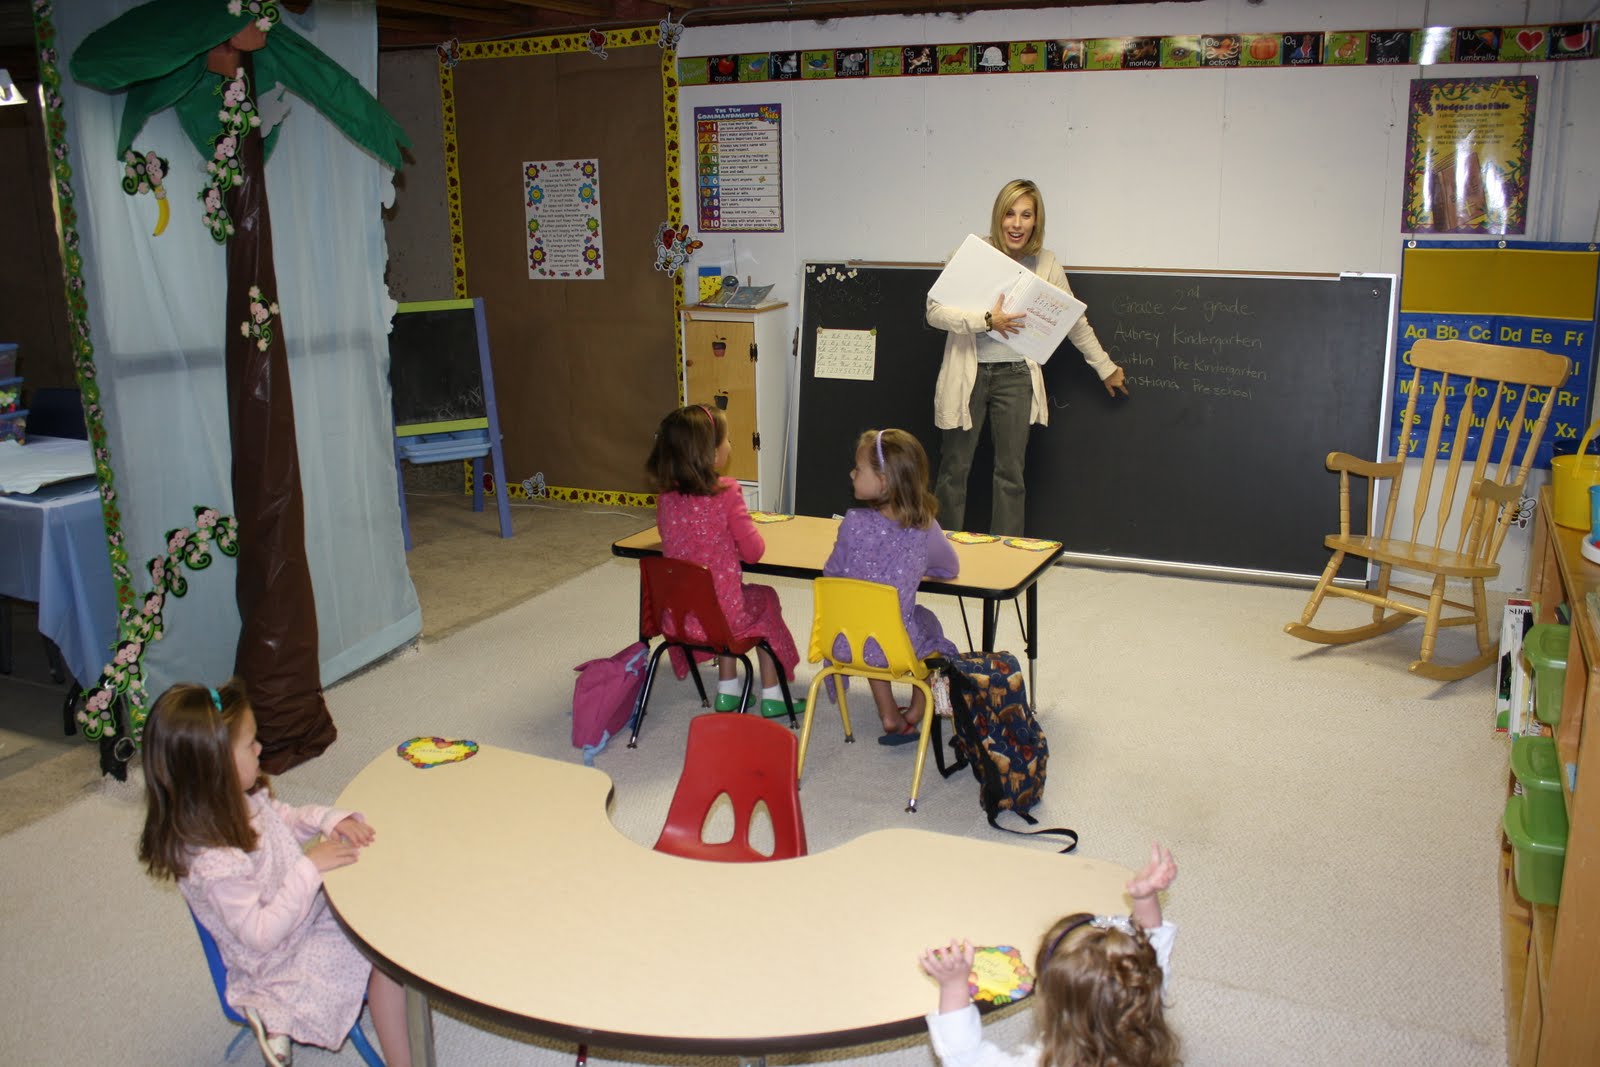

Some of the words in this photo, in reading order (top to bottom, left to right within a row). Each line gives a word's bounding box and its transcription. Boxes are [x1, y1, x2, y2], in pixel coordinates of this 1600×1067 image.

[1206, 38, 1220, 46] Oo
[1284, 36, 1296, 48] Qq
[1370, 34, 1382, 43] Ss
[904, 48, 914, 58] Gg
[1460, 53, 1496, 62] umbrella
[1129, 60, 1156, 68] monkey
[1290, 58, 1313, 66] queen
[1376, 56, 1400, 64] skunk
[917, 66, 933, 74] goat
[984, 64, 1002, 74] igloo
[1112, 296, 1165, 315] Grace
[1204, 297, 1256, 322] grade
[1114, 321, 1160, 348] Aubrey
[1173, 323, 1262, 352] Kindergarten
[1404, 325, 1428, 339] Aa
[1436, 325, 1459, 339] Bb
[1469, 326, 1491, 340] Cc
[1500, 328, 1522, 342] Dd
[1530, 329, 1553, 344] Ee
[1564, 331, 1584, 346] Ff
[1464, 383, 1488, 398] Oo
[1558, 391, 1580, 406] Rr
[1554, 422, 1577, 438] Xx
